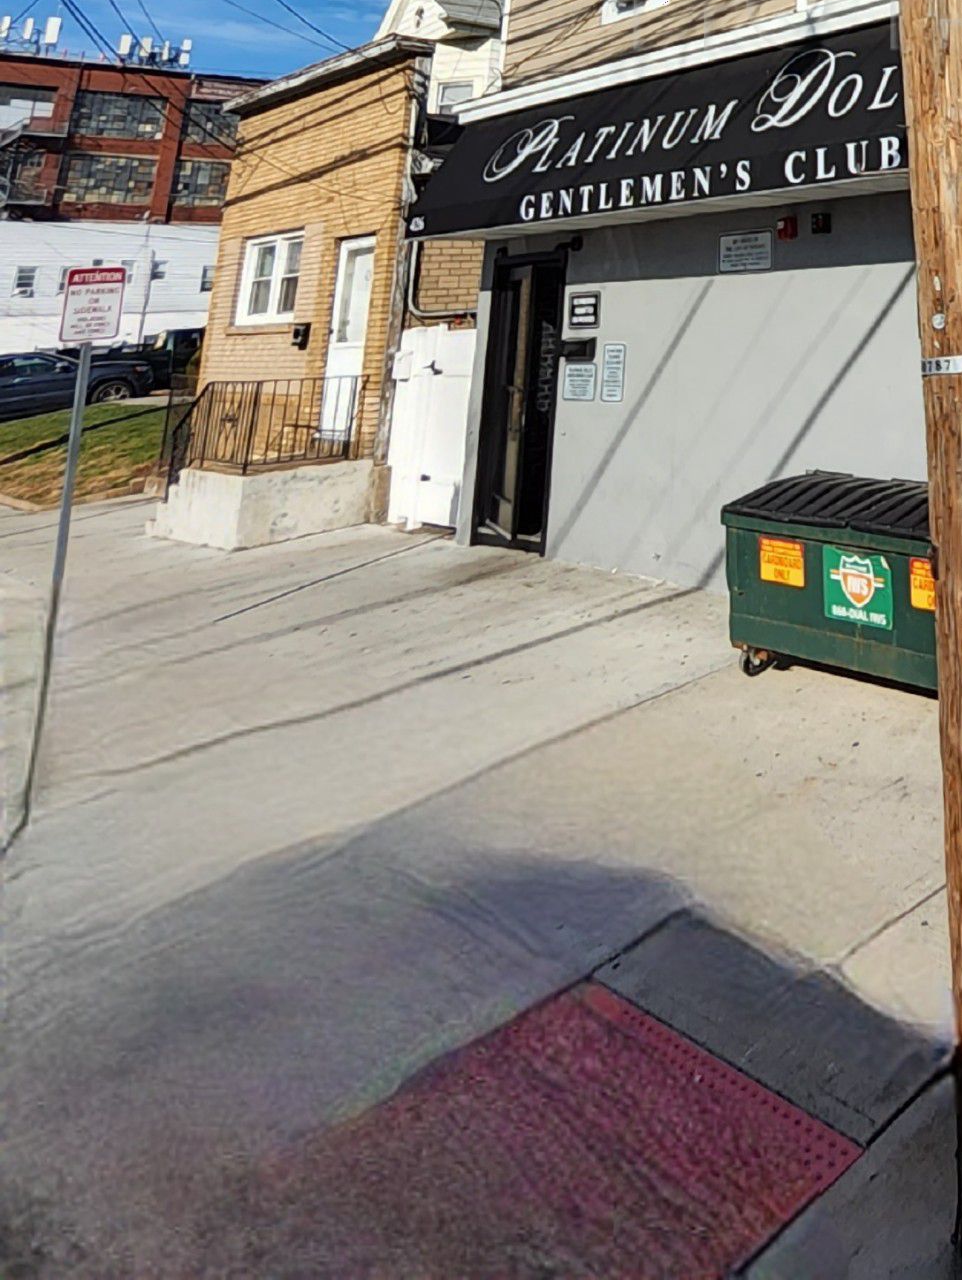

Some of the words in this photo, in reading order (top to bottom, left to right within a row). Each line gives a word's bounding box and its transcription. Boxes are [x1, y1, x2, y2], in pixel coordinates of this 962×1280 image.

[483, 99, 740, 183] PLATINUM
[519, 159, 752, 221] GENTLEMEN'S
[784, 136, 901, 184] CLUB
[72, 271, 123, 282] ATTENTION
